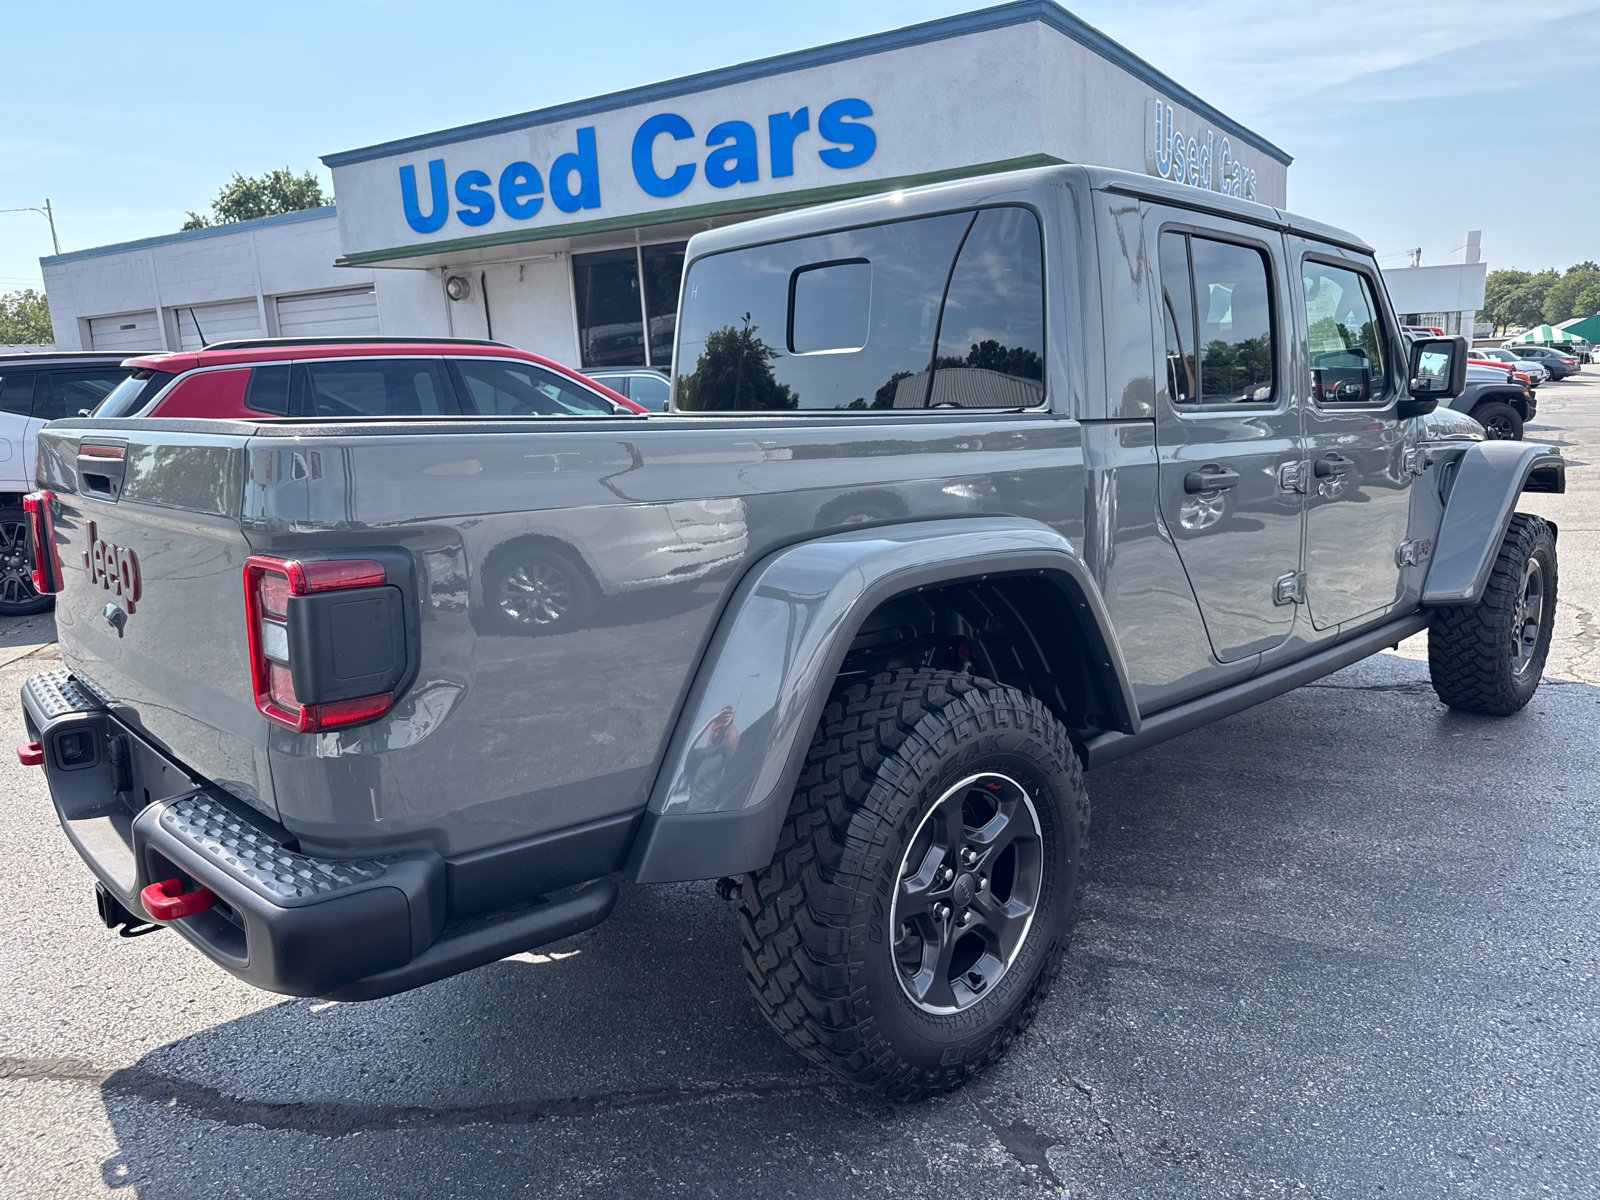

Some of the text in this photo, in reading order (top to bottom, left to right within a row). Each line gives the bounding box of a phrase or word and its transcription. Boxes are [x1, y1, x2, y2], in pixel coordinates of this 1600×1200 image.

[398, 97, 877, 234] Used Cars
[1155, 98, 1257, 202] Used Cars
[82, 520, 141, 614] Jeep
[869, 733, 1005, 944] WILDPEAK
